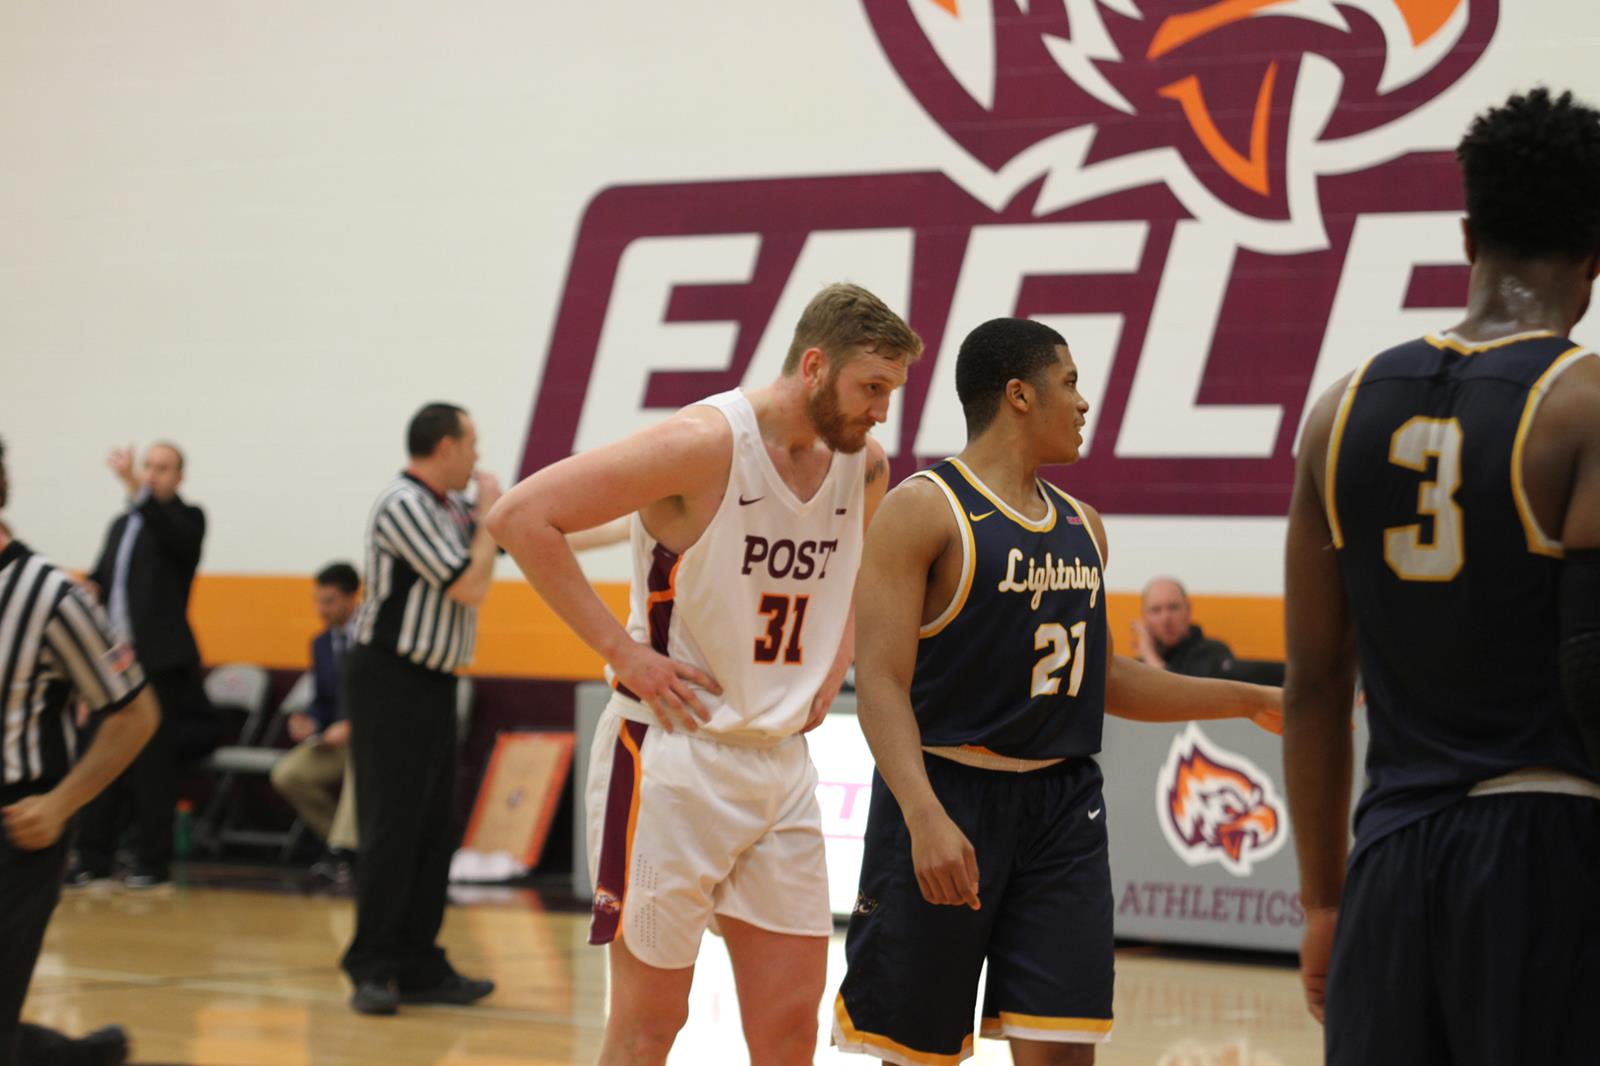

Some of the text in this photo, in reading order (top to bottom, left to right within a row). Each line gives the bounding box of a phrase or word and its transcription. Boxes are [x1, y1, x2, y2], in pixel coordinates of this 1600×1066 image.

[571, 214, 1600, 458] EAGLE
[1383, 415, 1465, 582] 3
[741, 534, 838, 580] POST
[998, 548, 1101, 610] Lightning
[752, 592, 810, 666] 31
[1030, 621, 1087, 699] 21
[1117, 881, 1305, 928] ATHLETICS
